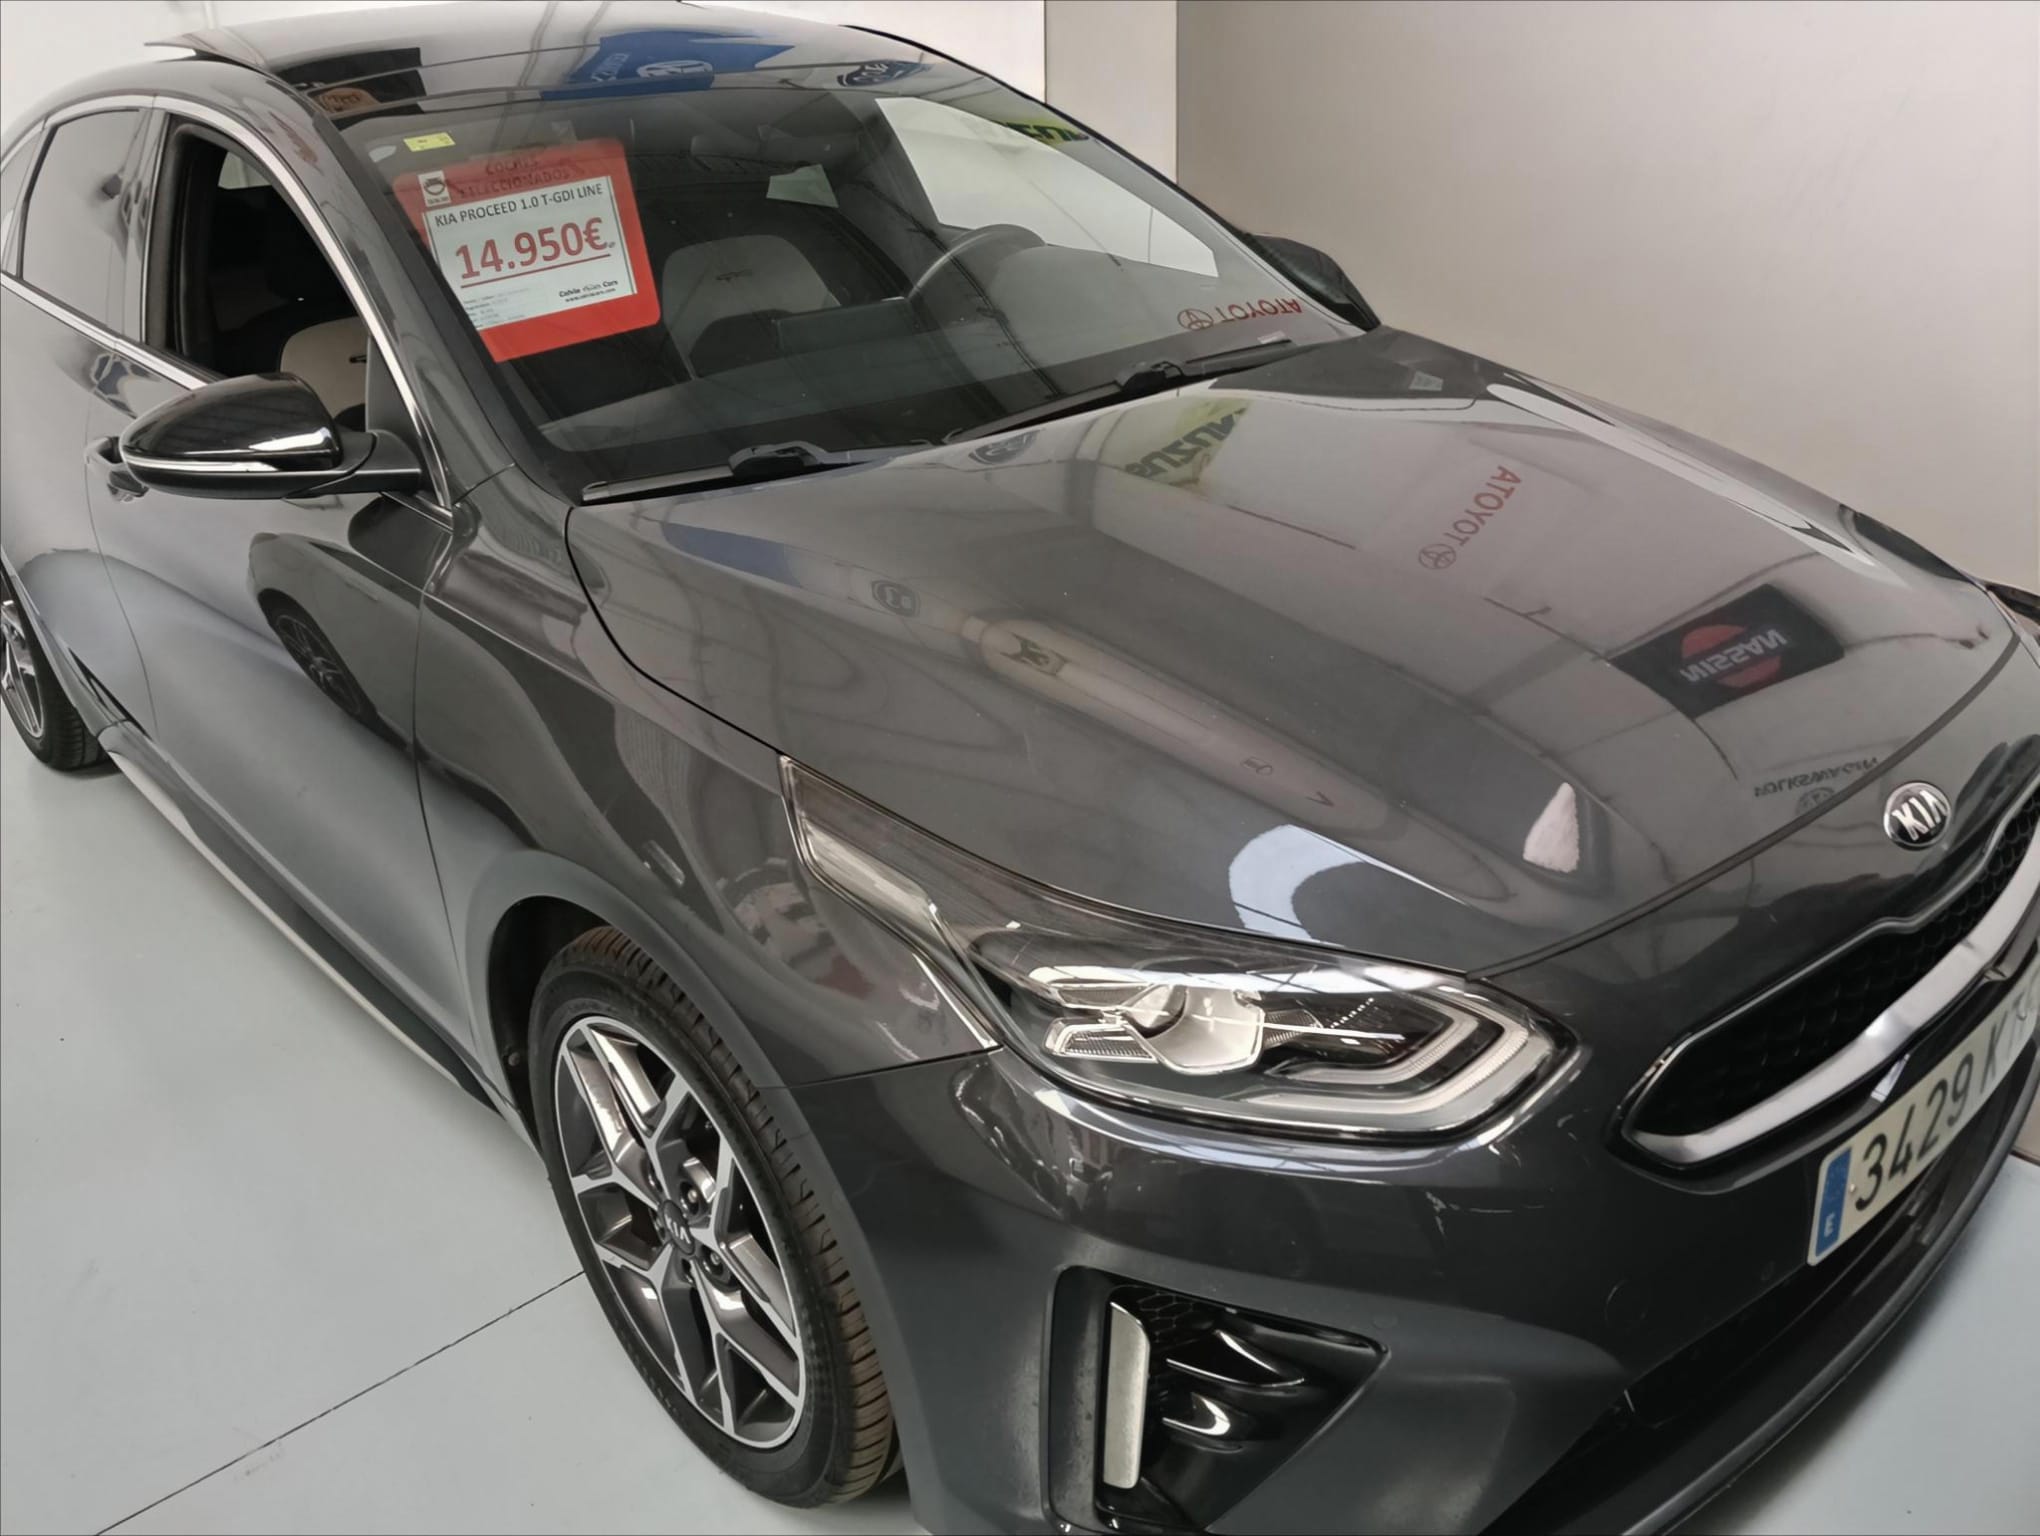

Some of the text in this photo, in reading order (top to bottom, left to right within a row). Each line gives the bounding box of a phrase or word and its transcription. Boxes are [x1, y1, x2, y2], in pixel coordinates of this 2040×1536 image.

[434, 184, 603, 227] KIA PROCEED 1.0 T-GDI LINE
[456, 217, 607, 279] 14.950€
[1891, 790, 1949, 842] KIA
[1855, 1053, 1974, 1211] 3429
[1824, 1212, 1836, 1237] E
